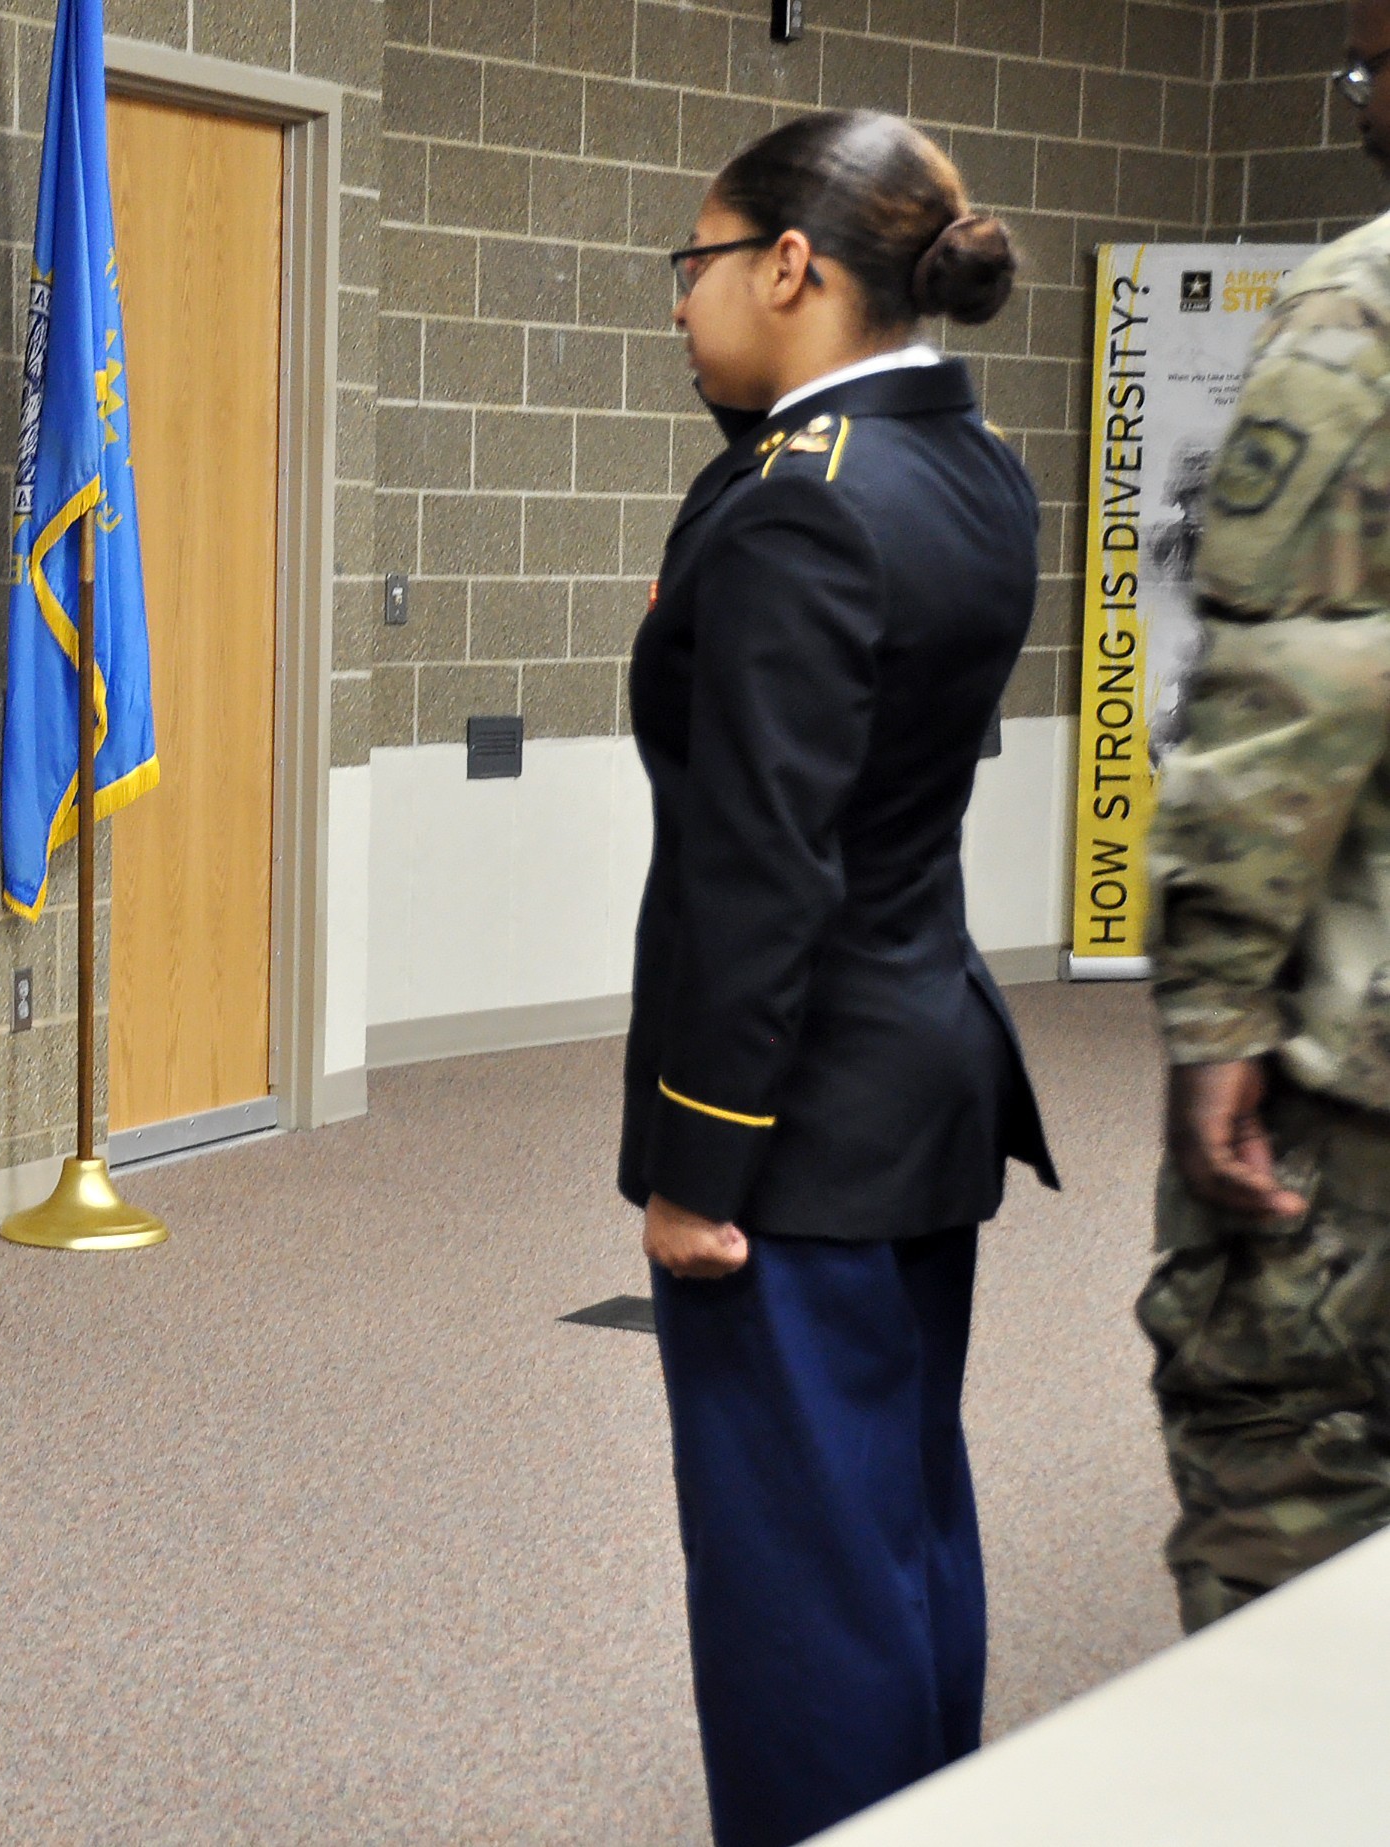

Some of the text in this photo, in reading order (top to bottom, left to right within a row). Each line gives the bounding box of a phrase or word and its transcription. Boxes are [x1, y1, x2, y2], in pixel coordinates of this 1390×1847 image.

[1090, 275, 1151, 945] HOW STRONG IS DIVERSITY?
